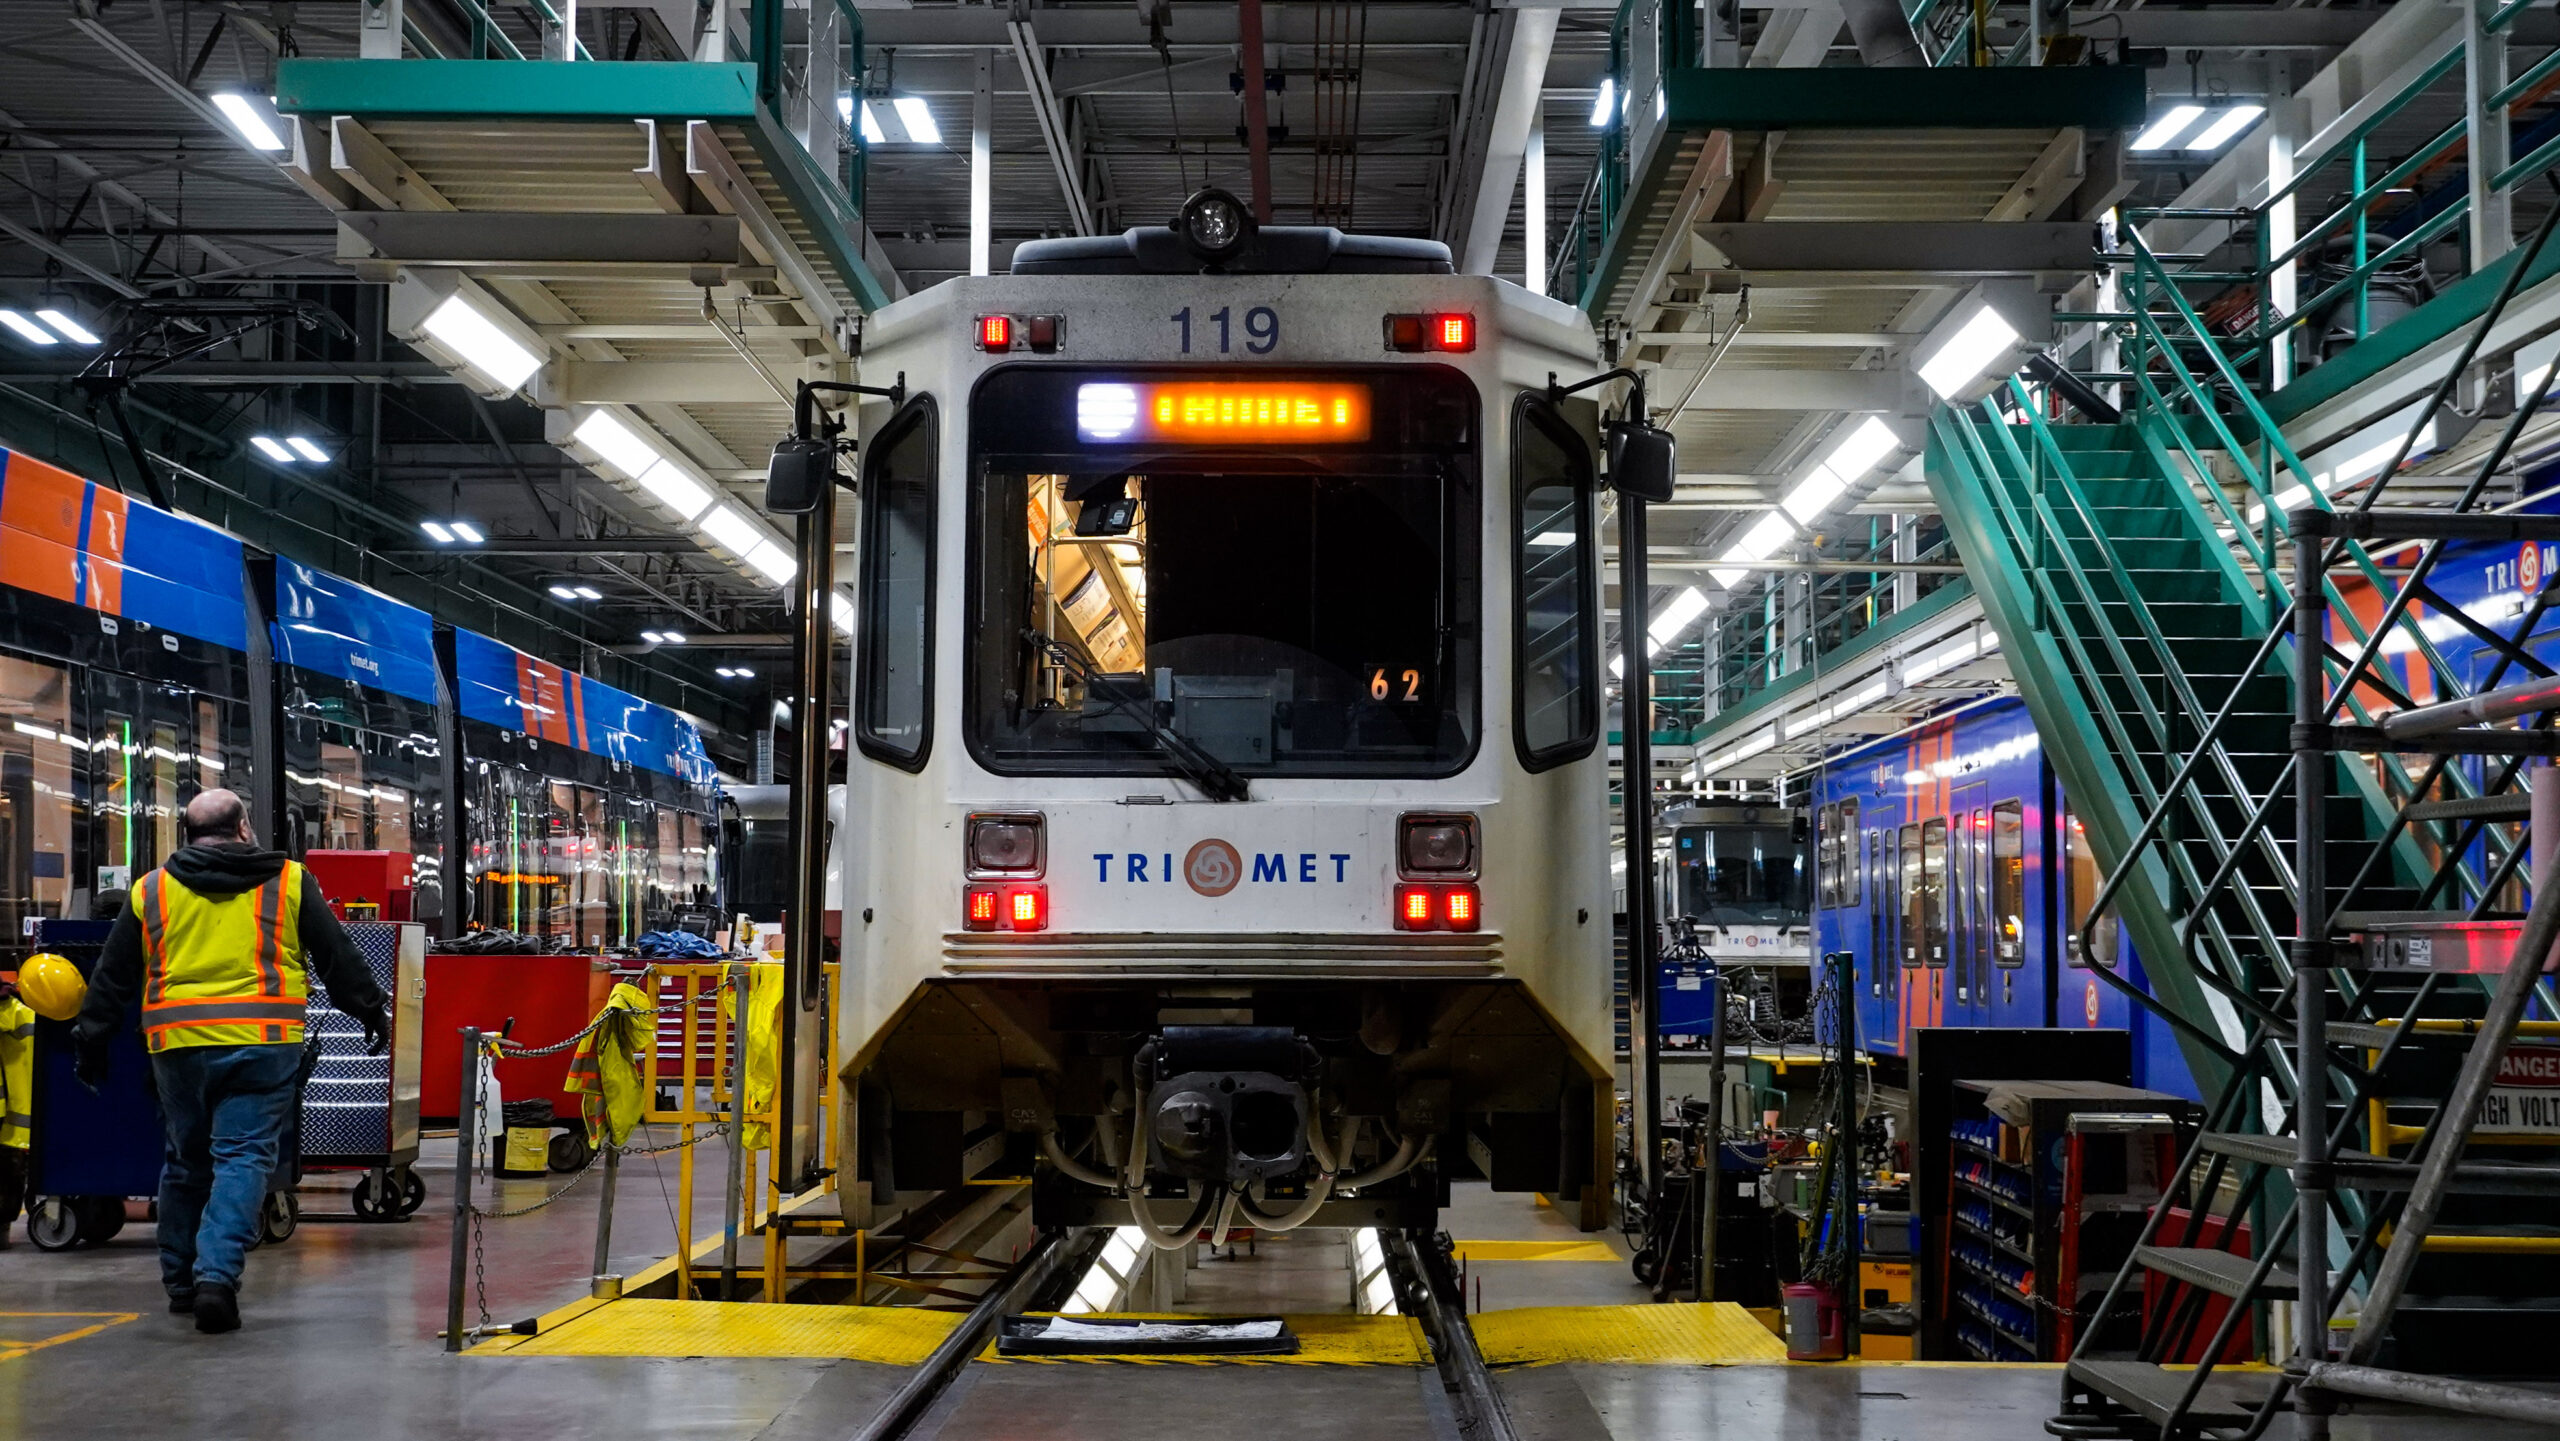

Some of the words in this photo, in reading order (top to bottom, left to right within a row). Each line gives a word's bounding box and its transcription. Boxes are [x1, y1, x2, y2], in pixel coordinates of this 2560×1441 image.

[1170, 306, 1279, 355] 119
[2232, 304, 2260, 331] DANGE
[2484, 558, 2515, 593] TRI
[2542, 545, 2558, 577] M
[1093, 853, 1172, 883] TRI
[1251, 853, 1350, 883] MET
[2499, 1056, 2560, 1078] ANGE
[2476, 1095, 2510, 1126] IGH
[2519, 1096, 2560, 1128] VOLT
